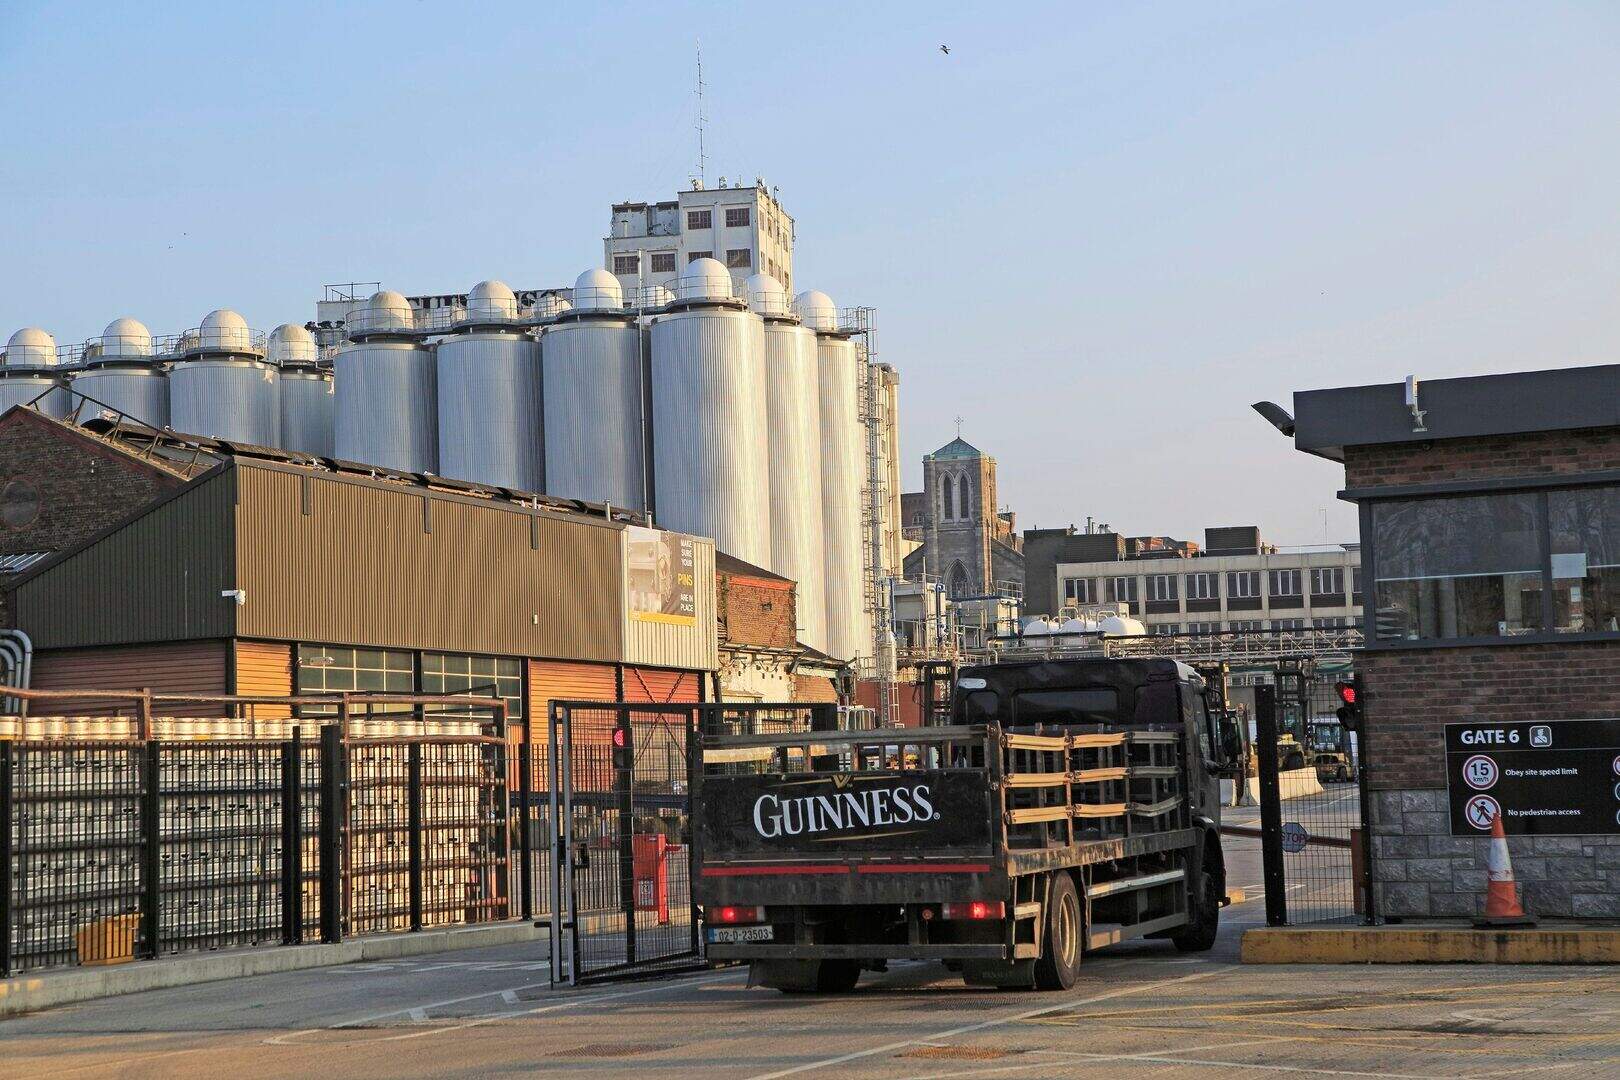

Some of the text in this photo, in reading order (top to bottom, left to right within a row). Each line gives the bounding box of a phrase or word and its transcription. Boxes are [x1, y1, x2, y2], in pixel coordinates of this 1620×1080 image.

[677, 573, 693, 586] PINS
[680, 603, 693, 612] PLACE
[1460, 729, 1520, 745] GATE 6
[1470, 763, 1489, 776] 15
[1505, 769, 1523, 777] Obey
[1539, 769, 1560, 777] speed
[1561, 767, 1578, 775] limit
[753, 785, 934, 838] GUINNESS
[1519, 809, 1556, 817] pedestrian
[1281, 831, 1305, 843] STOP
[718, 929, 769, 943] 02-D-23503
